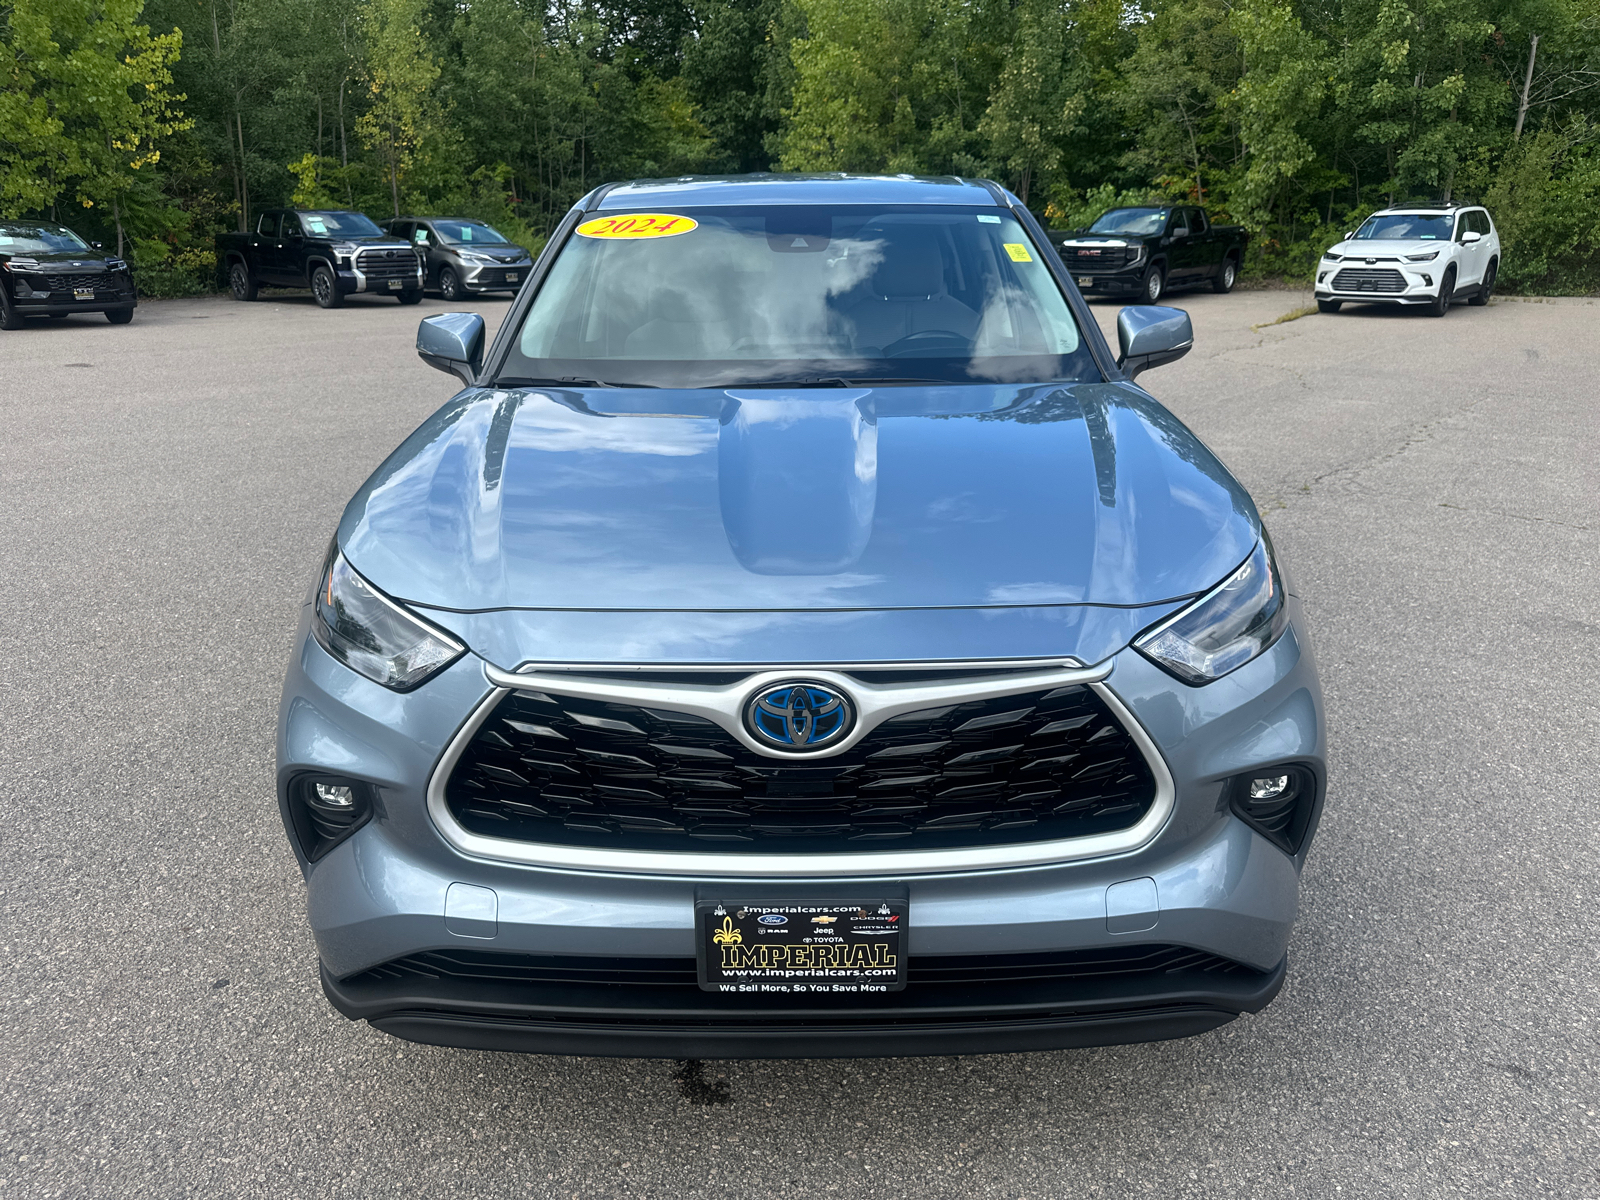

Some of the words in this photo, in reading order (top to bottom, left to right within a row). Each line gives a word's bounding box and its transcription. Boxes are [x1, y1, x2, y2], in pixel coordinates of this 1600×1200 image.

[590, 218, 681, 235] 2024
[743, 906, 861, 915] Imperialcars.com
[764, 916, 782, 924] Ford
[721, 944, 897, 968] IMPERIAL
[721, 968, 896, 977] www.imperialcars.com
[719, 984, 736, 992] We
[738, 984, 758, 992] Sell
[761, 984, 790, 993] More,
[793, 984, 807, 992] So
[809, 984, 829, 992] You
[832, 984, 857, 992] Save
[860, 984, 887, 992] More
